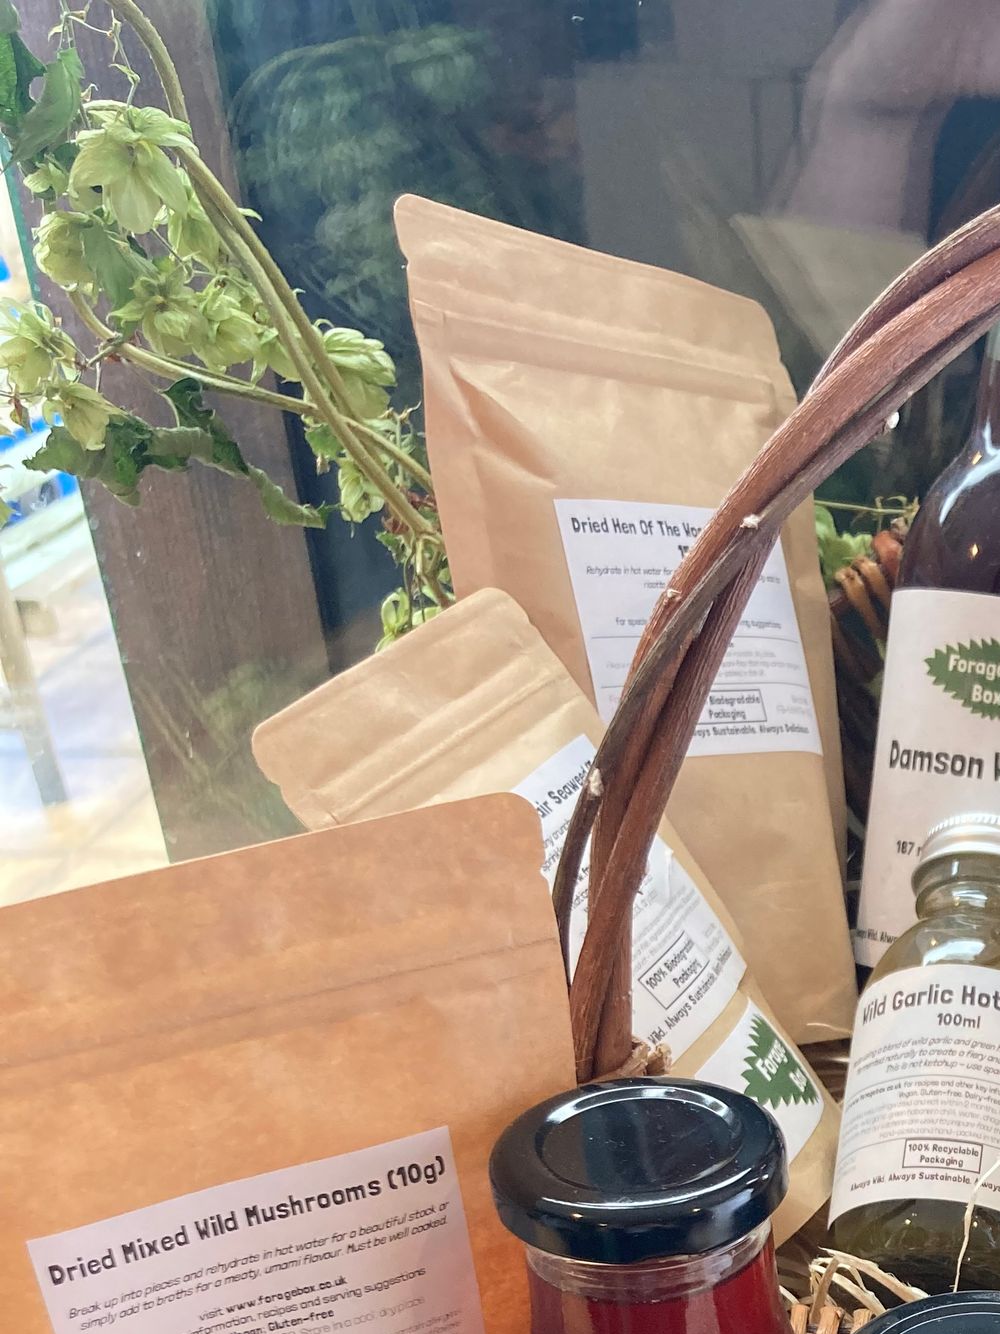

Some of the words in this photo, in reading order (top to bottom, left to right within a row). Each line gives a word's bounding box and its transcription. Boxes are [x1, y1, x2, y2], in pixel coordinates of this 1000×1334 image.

[570, 516, 609, 534] Dried
[611, 518, 637, 535] Hen
[639, 519, 654, 536] Of
[656, 520, 681, 538] The
[889, 740, 984, 780] Damson
[896, 839, 916, 856] 187
[862, 996, 886, 1026] Wild
[892, 984, 954, 1012] Garlic
[937, 1012, 981, 1030] 100ml
[48, 1246, 117, 1287] Dried
[120, 1225, 190, 1265] Mixed
[194, 1211, 239, 1242] Wild
[244, 1176, 383, 1228] Mushrooms
[386, 1155, 446, 1192] (10g)
